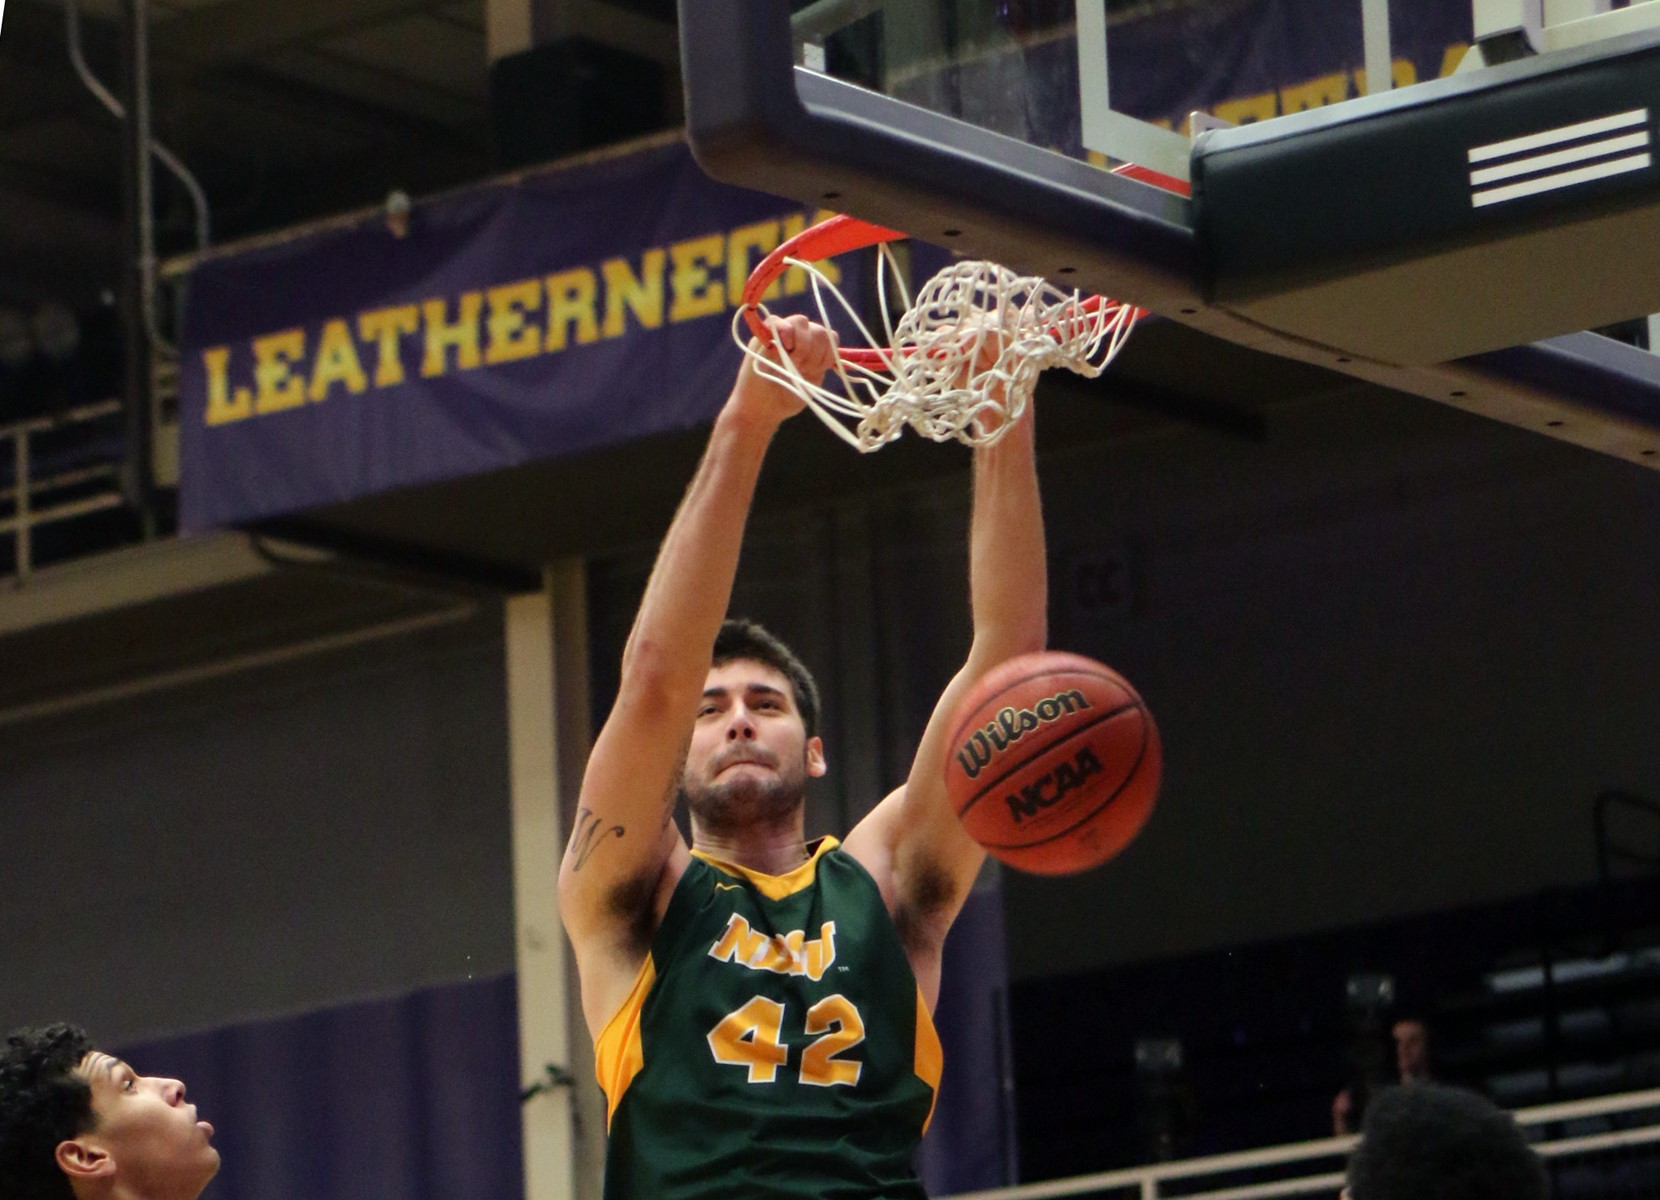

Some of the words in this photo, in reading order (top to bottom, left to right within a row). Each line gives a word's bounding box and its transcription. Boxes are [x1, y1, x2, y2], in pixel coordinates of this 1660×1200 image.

[956, 689, 1090, 779] Wilson
[1005, 746, 1103, 824] NCAA
[707, 994, 866, 1086] 42
